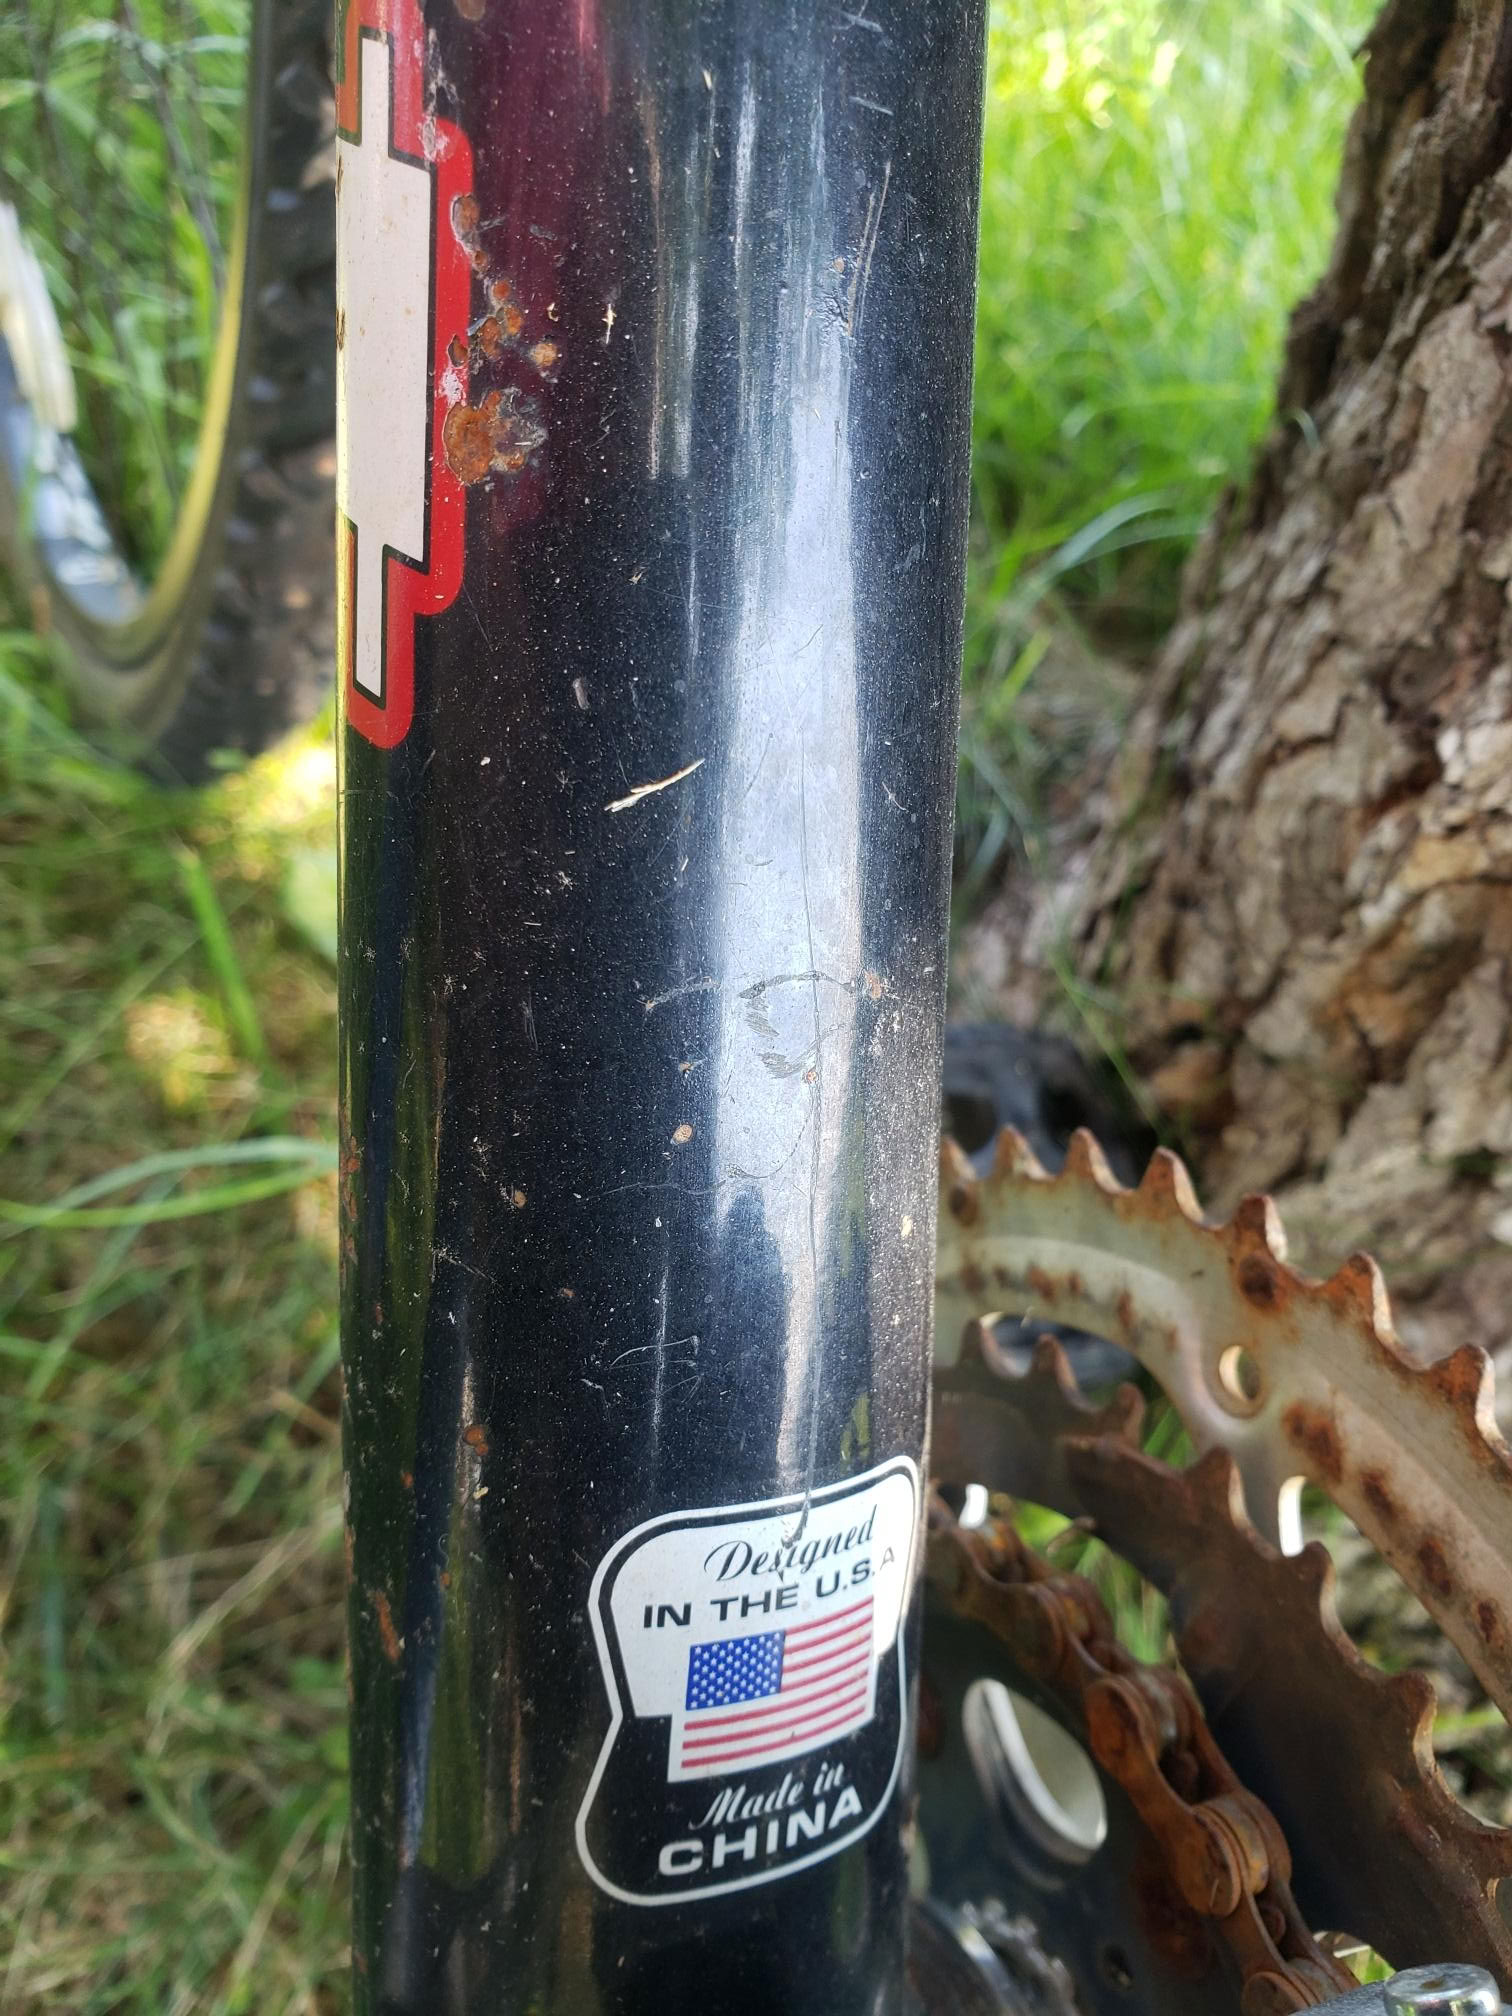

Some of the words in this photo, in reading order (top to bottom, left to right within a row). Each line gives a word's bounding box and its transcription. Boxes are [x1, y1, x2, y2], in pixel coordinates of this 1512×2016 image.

[703, 1504, 877, 1581] Designed
[643, 1603, 691, 1628] IN
[710, 1585, 798, 1621] THE
[658, 1785, 862, 1876] CHINA
[689, 1780, 804, 1829] Made
[812, 1761, 844, 1797] in
